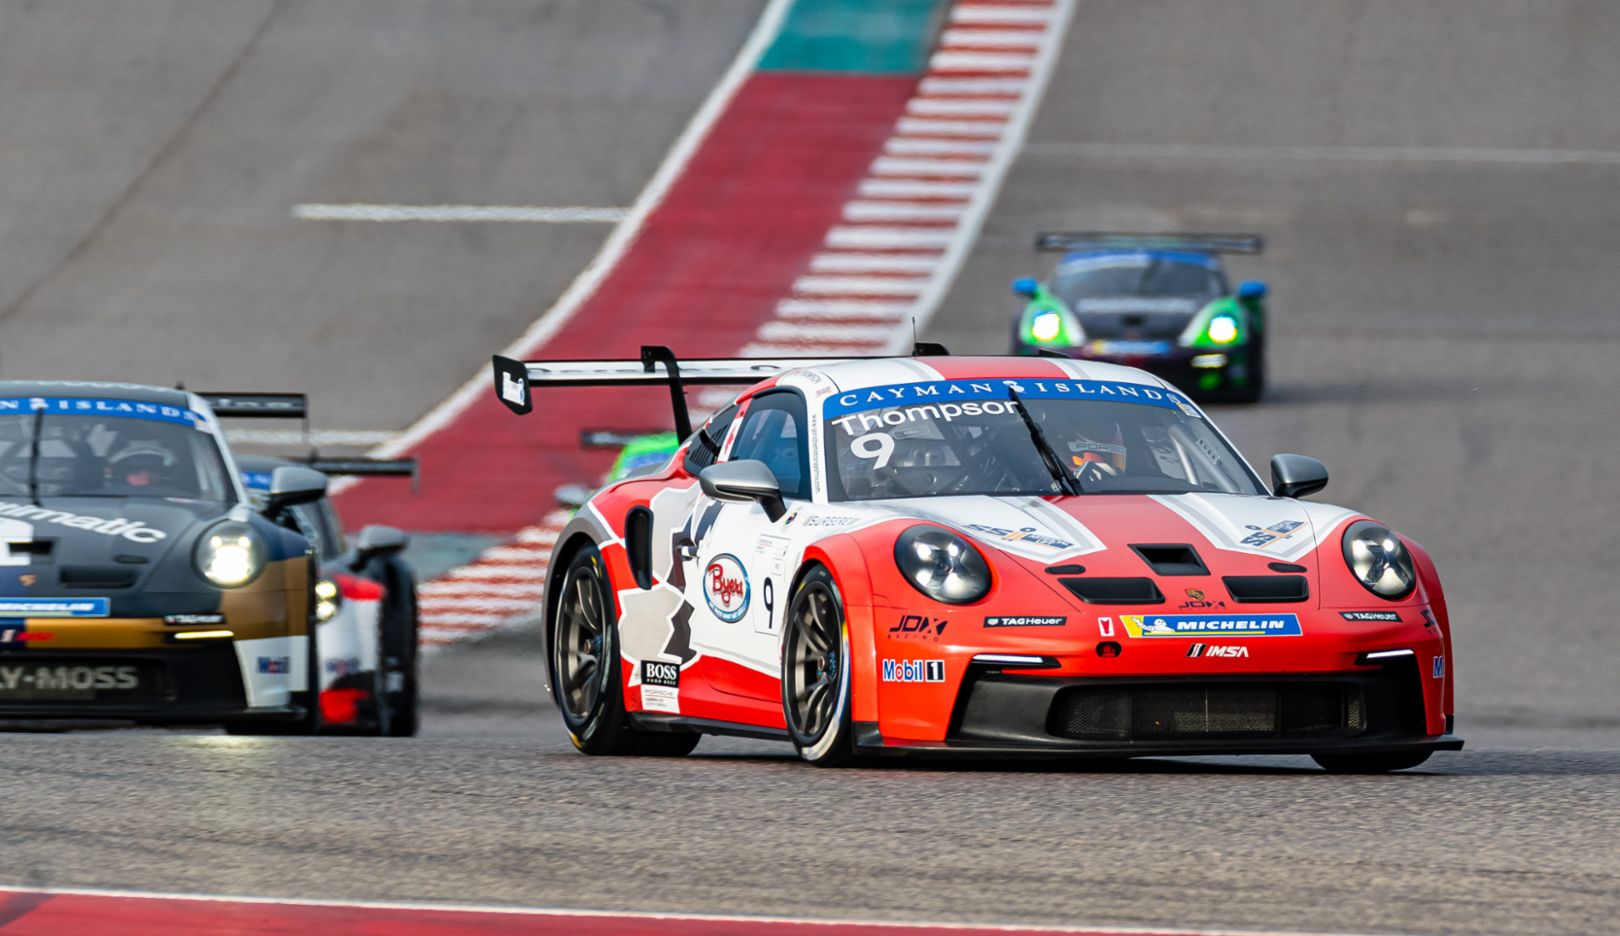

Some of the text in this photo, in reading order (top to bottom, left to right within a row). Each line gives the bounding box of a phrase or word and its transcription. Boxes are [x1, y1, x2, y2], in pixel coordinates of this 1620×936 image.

[839, 383, 993, 407] CAYMAN
[1035, 382, 1181, 404] ISLANDS
[850, 432, 895, 471] 9
[763, 577, 774, 630] 9
[1177, 619, 1285, 631] MICHELIN
[1205, 645, 1249, 658] IMSA
[0, 666, 139, 690] Y-MOSS
[646, 663, 678, 681] BOSS
[883, 660, 923, 681] Mobil
